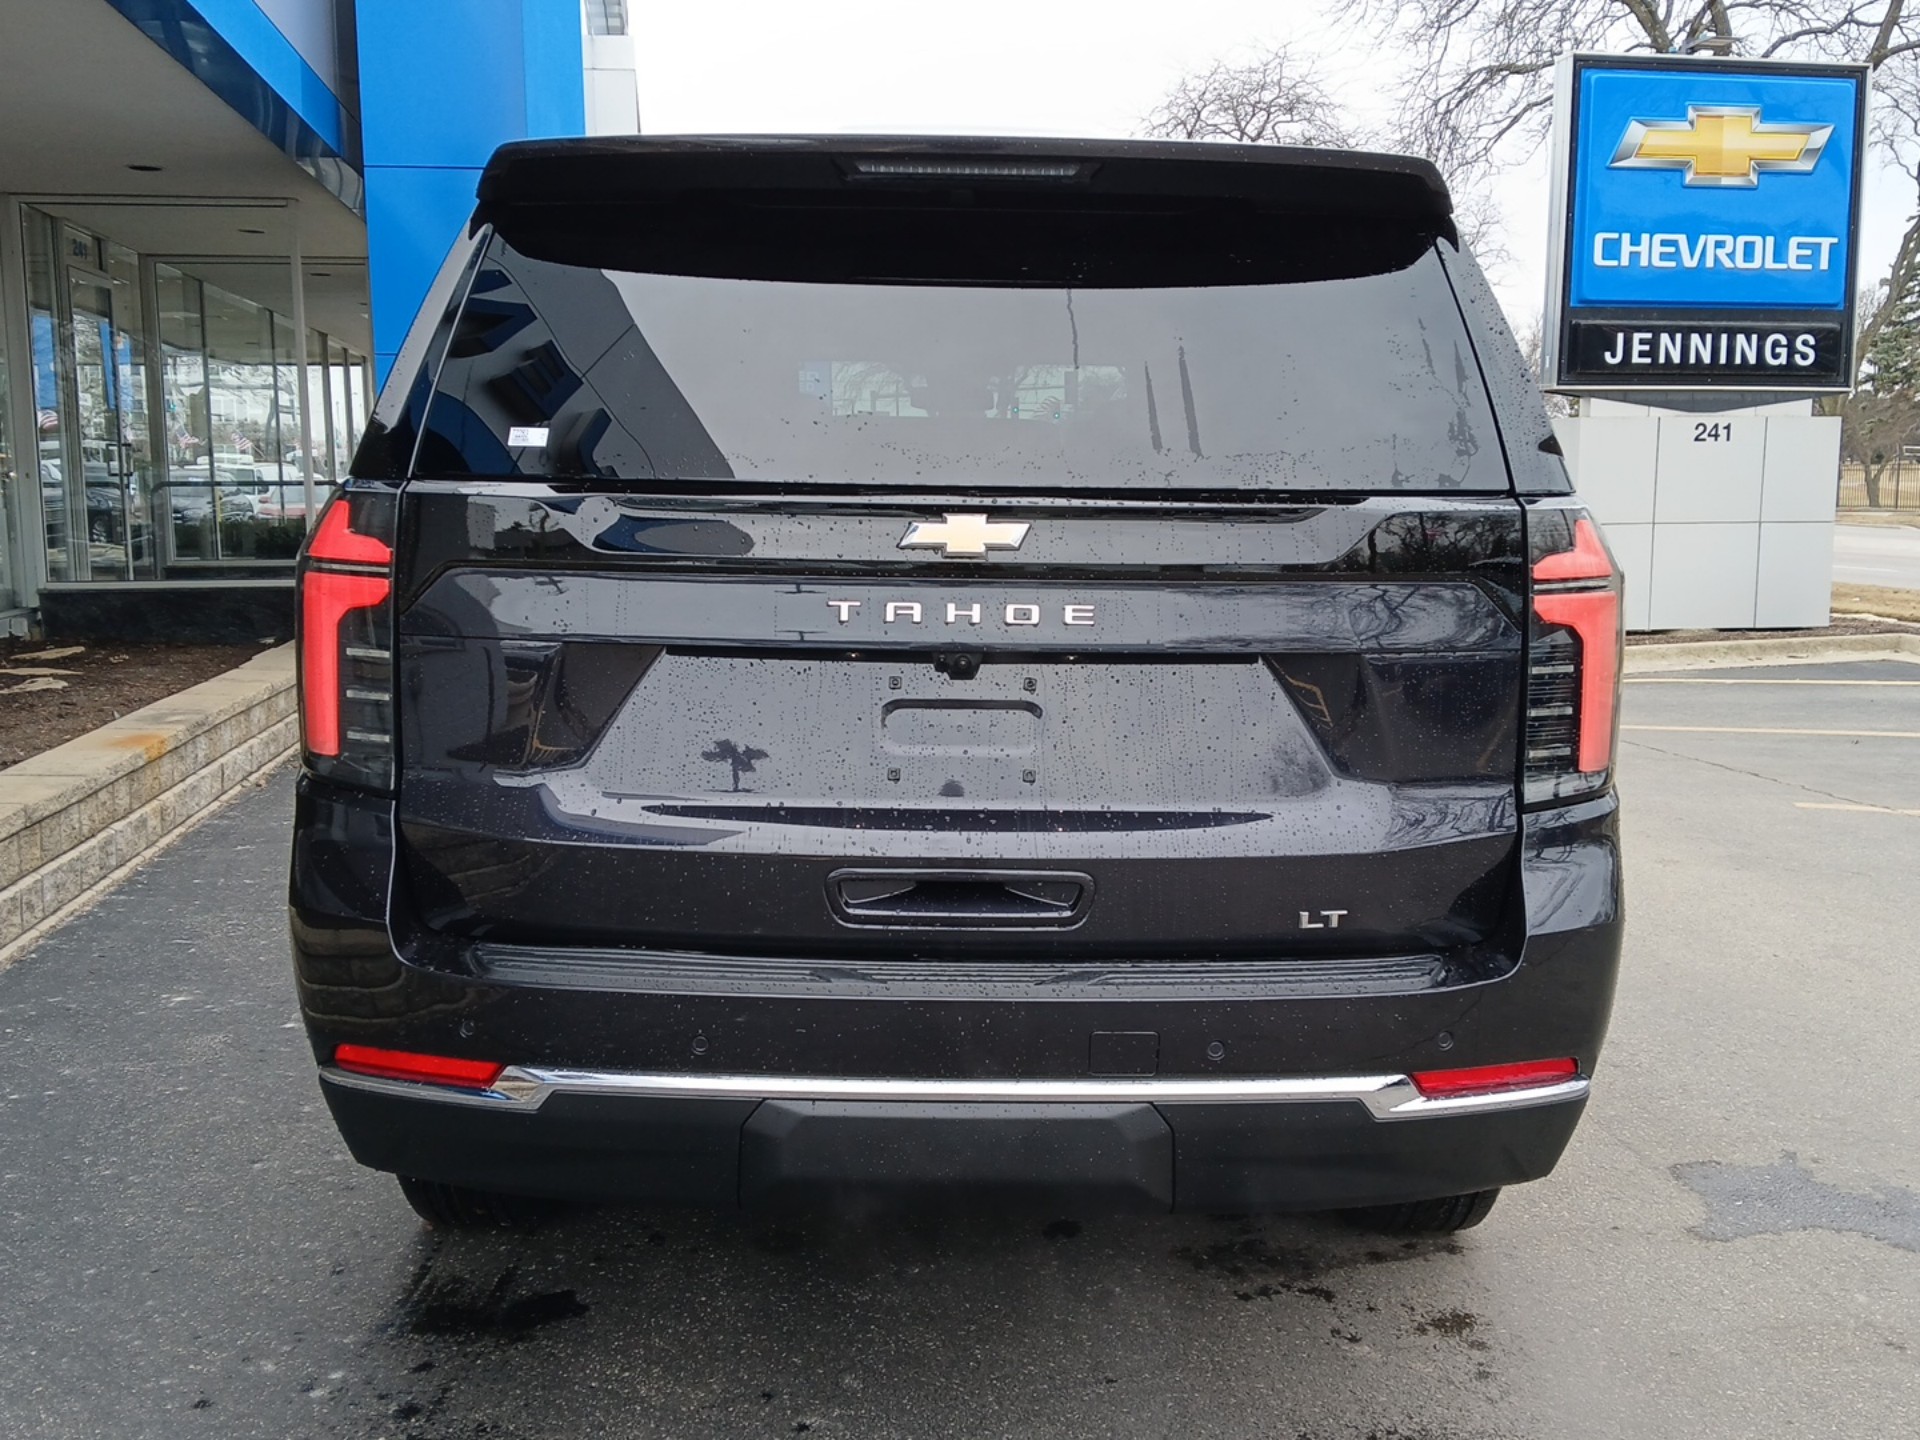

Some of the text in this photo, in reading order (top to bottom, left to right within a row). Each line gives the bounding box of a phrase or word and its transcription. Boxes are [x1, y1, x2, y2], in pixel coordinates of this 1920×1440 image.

[1593, 232, 1839, 271] CHEVROLET
[1604, 332, 1817, 366] JENNINGS
[1693, 422, 1731, 442] 241
[827, 600, 1096, 626] TAHOE
[1299, 910, 1348, 929] LT
